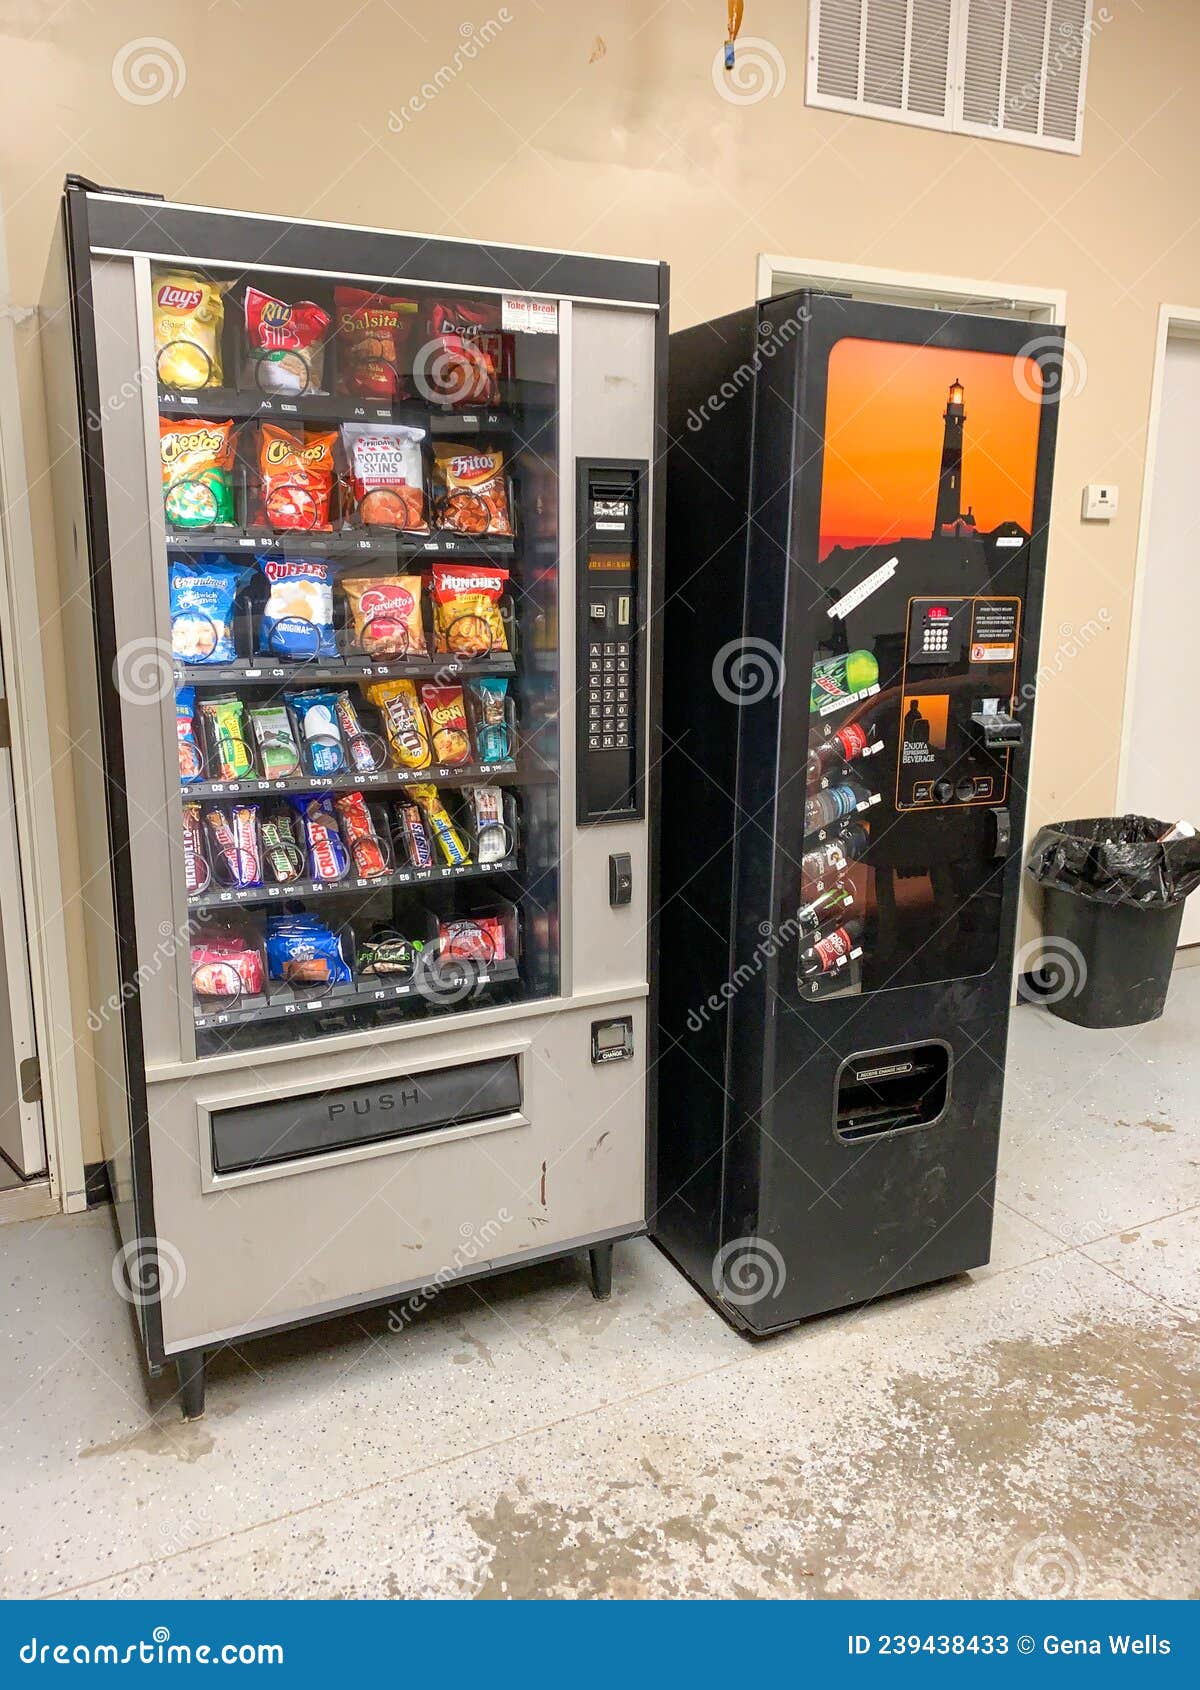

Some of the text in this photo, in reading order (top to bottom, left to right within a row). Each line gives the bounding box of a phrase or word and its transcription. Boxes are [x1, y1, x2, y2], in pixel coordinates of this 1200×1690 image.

[488, 415, 498, 423] A7
[161, 430, 224, 463] Cheetos
[357, 452, 403, 463] POTATO
[364, 463, 398, 473] SKINS
[449, 456, 494, 477] Fritos
[441, 574, 501, 591] MUNCHIES
[359, 590, 412, 623] Gardetto's
[277, 622, 312, 635] ORIGINAL
[432, 706, 463, 724] CORN
[904, 741, 924, 750] ENJOY
[903, 755, 935, 763] BEVERAGE
[435, 818, 464, 865] Butterfinger
[308, 821, 339, 878] CRUNCH
[375, 991, 384, 999] F5
[286, 1005, 295, 1013] F3
[218, 1015, 228, 1023] F1
[603, 1050, 622, 1059] CHANGE
[328, 1089, 418, 1121] PUSH
